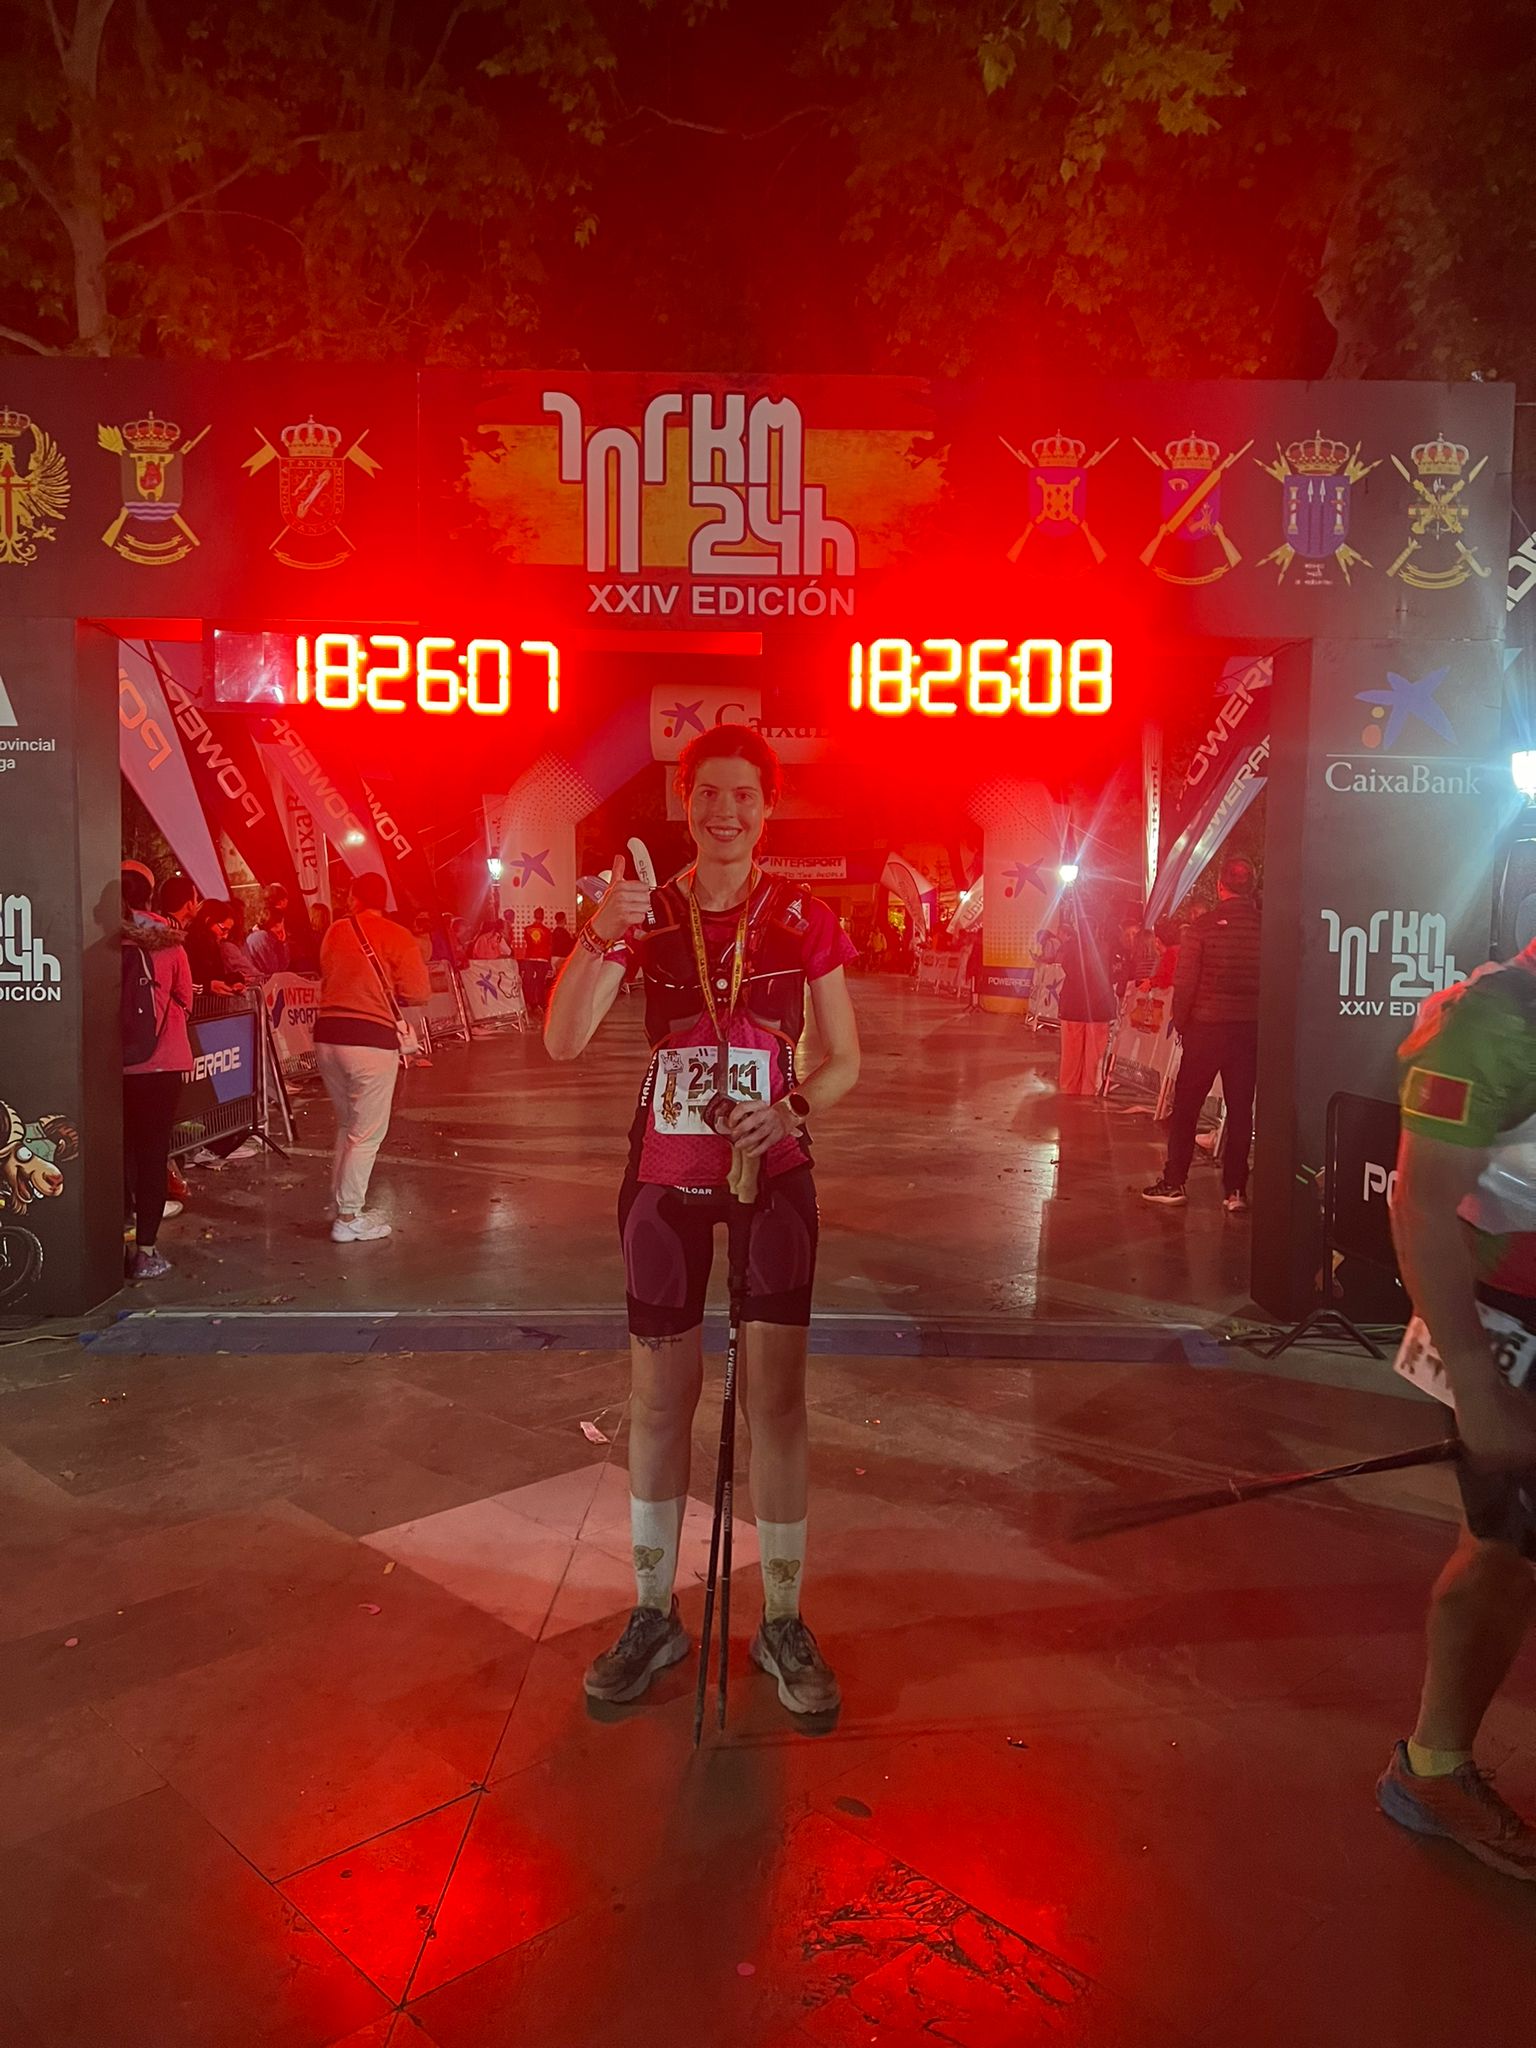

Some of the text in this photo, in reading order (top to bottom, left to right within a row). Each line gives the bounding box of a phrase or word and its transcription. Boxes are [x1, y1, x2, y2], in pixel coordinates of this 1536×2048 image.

[691, 484, 856, 576] 24h
[588, 580, 854, 616] XXIV EDICIÓN
[297, 633, 559, 716] 18:26:07
[849, 637, 1113, 716] 18:26:08
[1325, 761, 1481, 794] CaixaBank
[771, 857, 842, 868] INTERSPORT
[0, 893, 31, 951] M
[1339, 1001, 1385, 1015] XXIV
